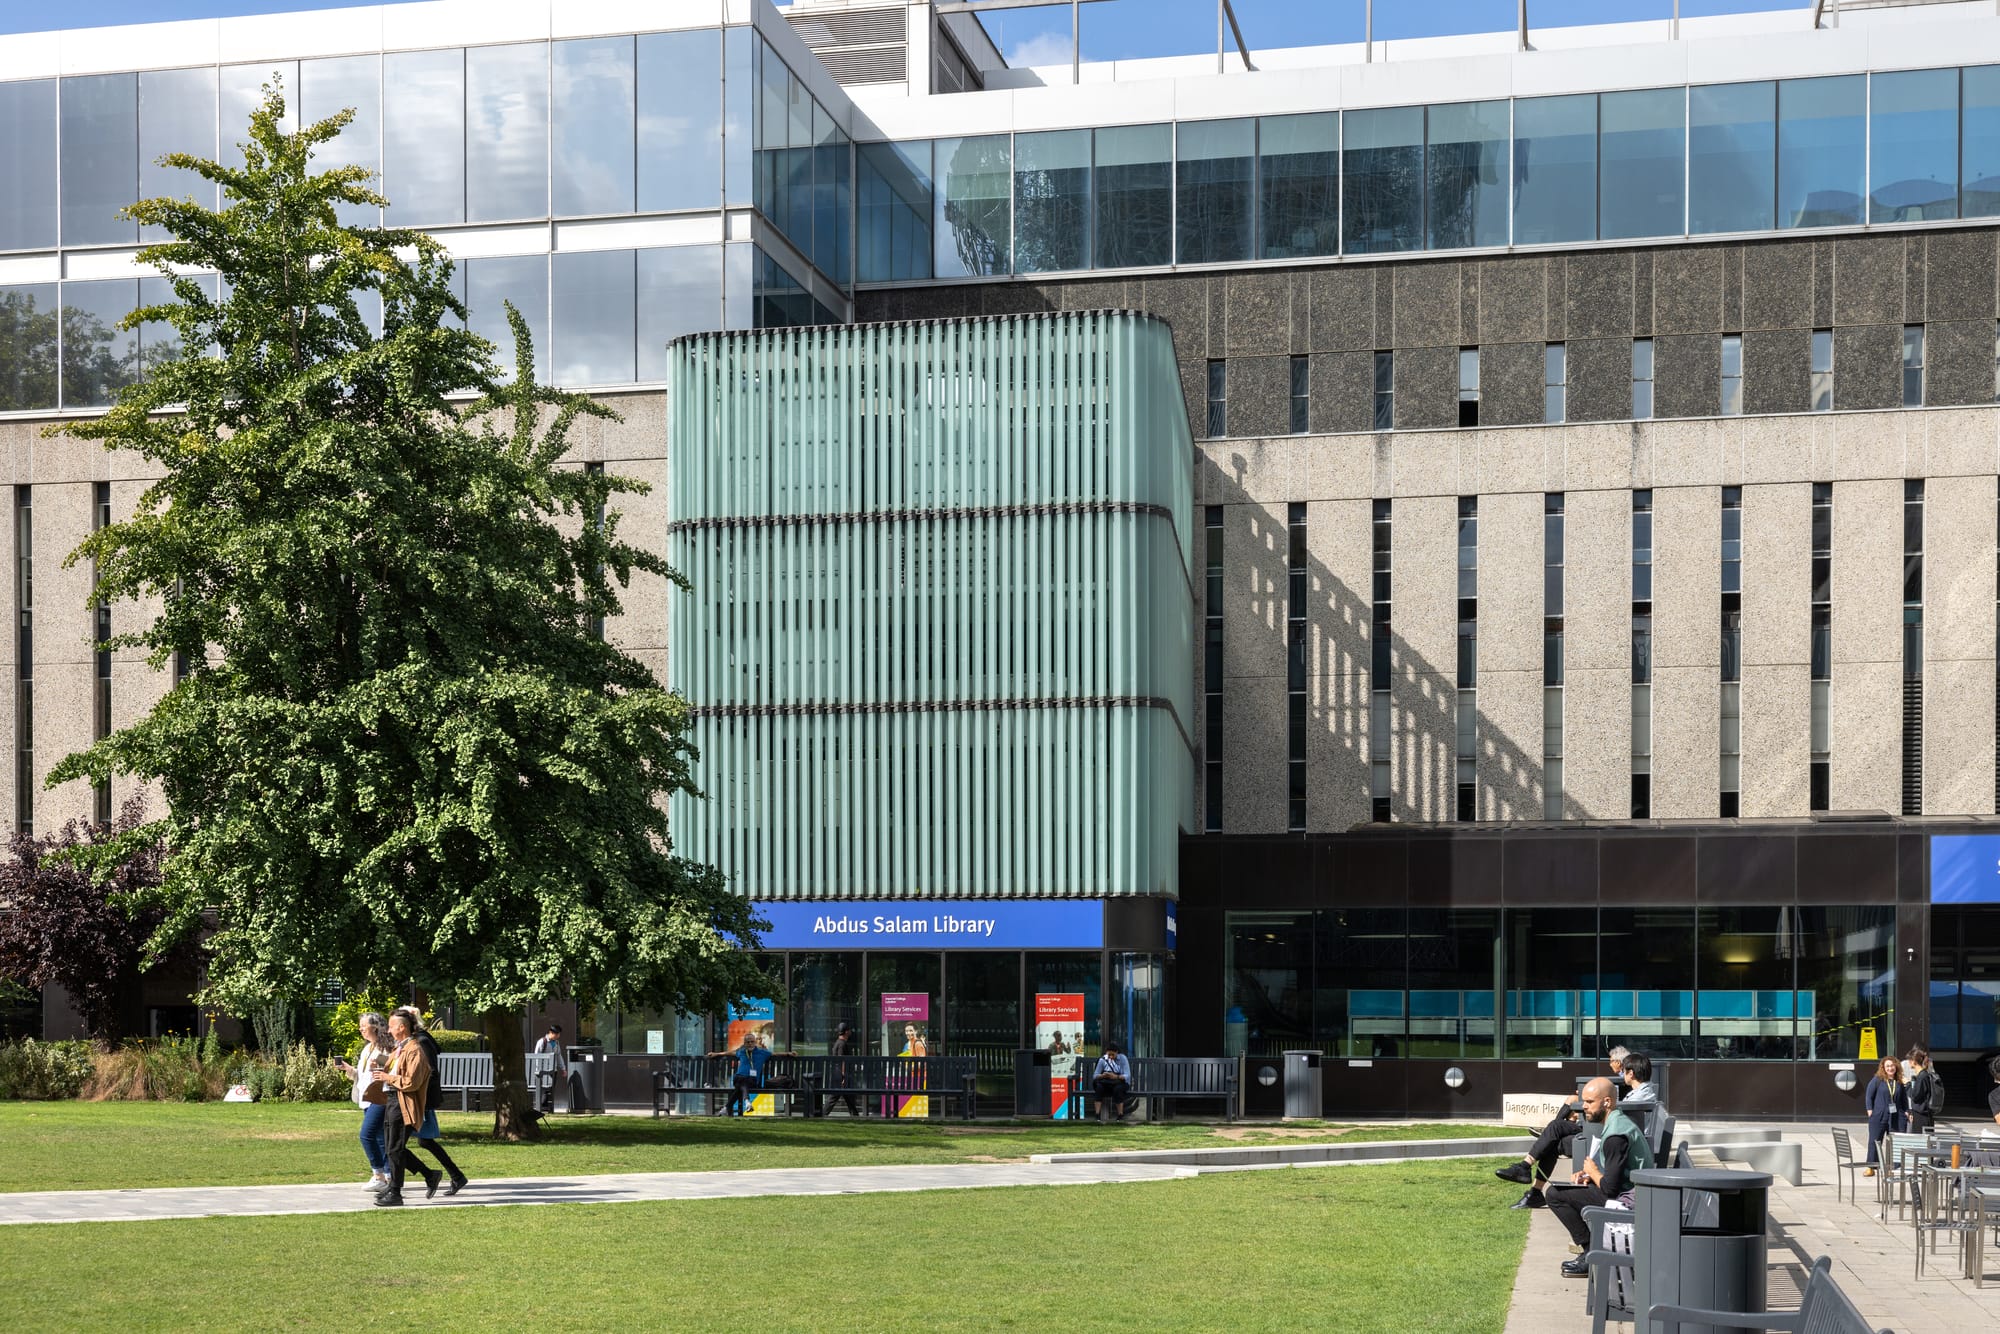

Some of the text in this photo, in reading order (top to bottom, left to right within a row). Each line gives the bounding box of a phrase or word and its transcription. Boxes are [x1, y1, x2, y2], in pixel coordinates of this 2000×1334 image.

[813, 915, 996, 937] Abdus Salam Library
[1039, 1006, 1057, 1014] Library
[1505, 1101, 1560, 1116] Dangoor Plaz
